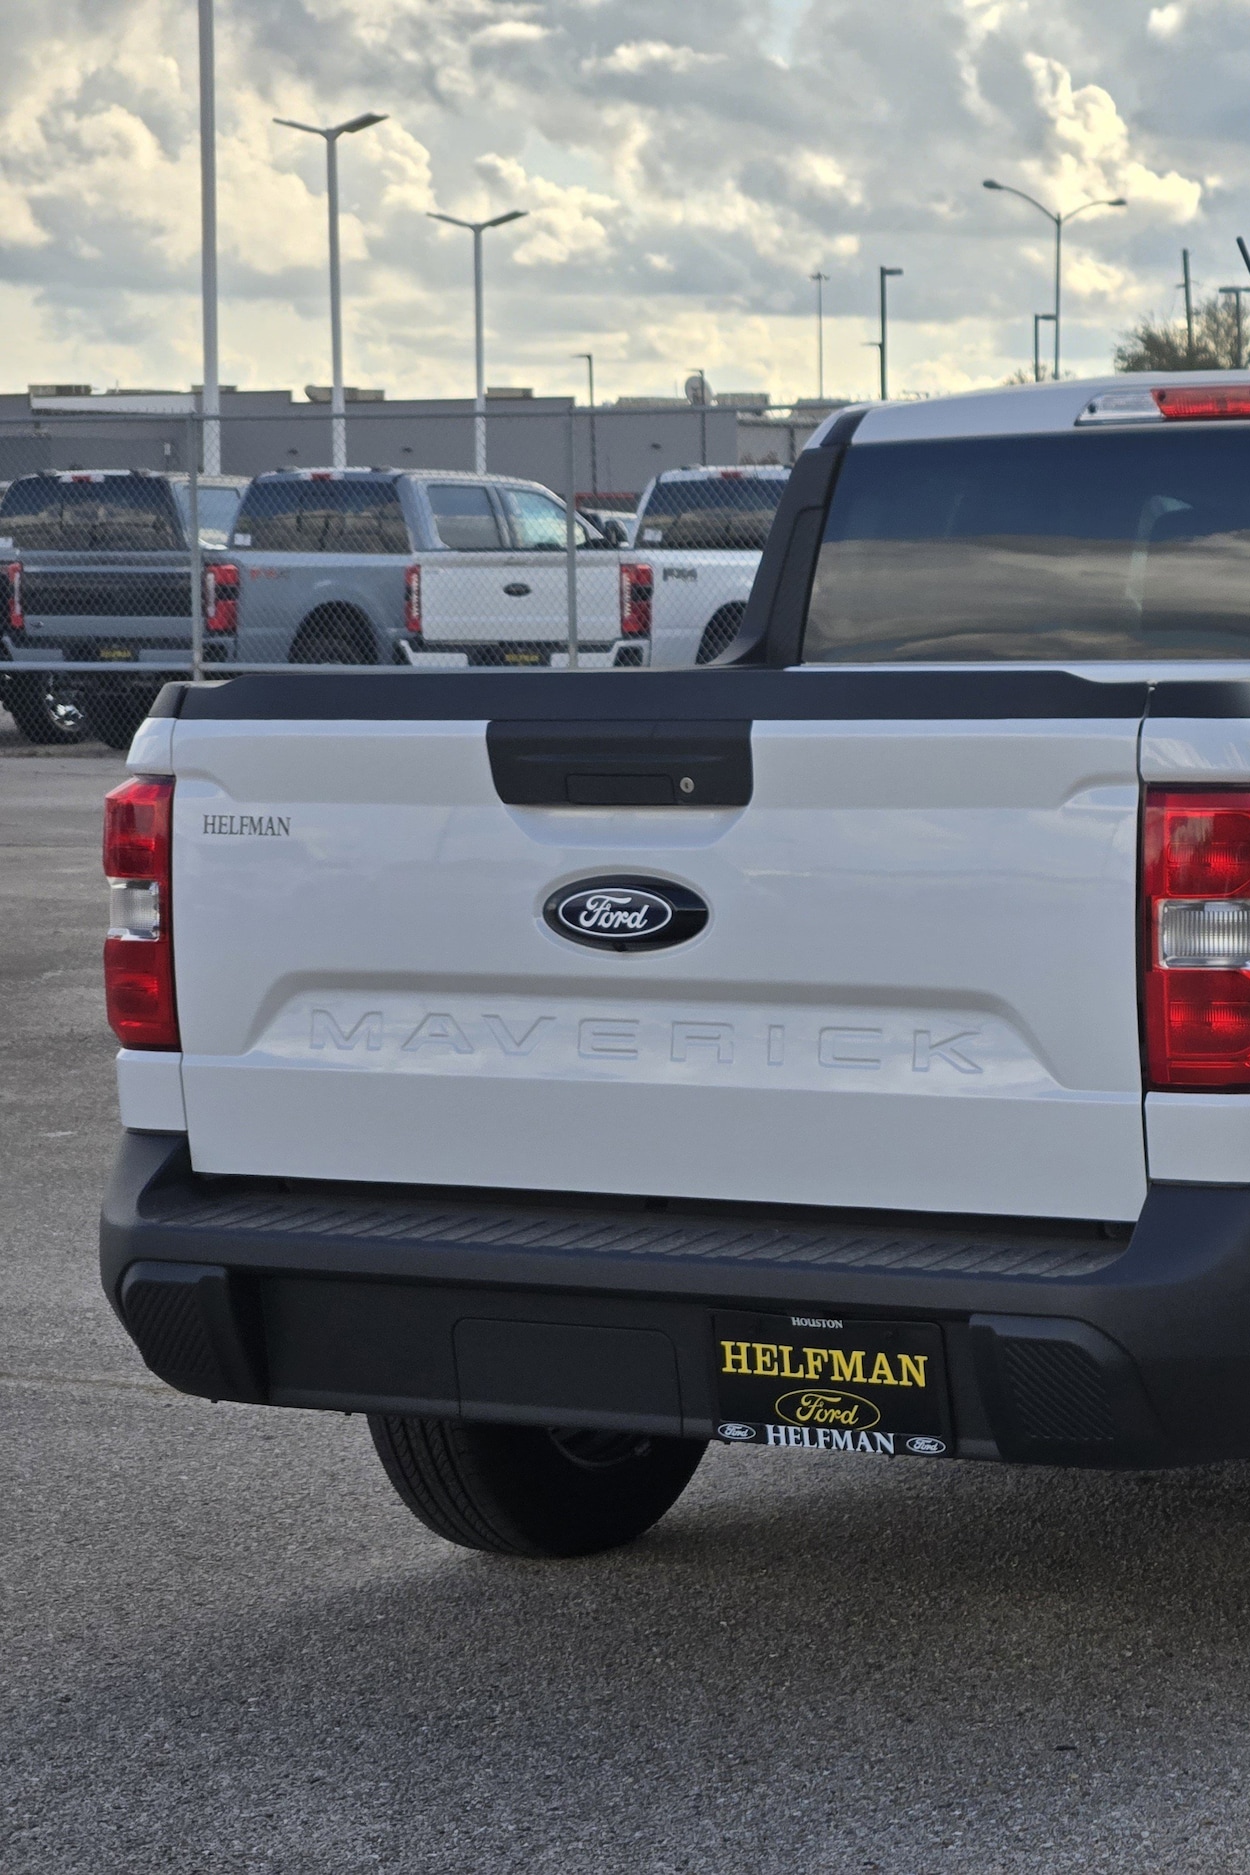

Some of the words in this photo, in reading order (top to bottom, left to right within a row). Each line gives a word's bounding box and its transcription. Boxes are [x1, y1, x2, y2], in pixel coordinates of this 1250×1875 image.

[202, 814, 291, 837] HELFMAN
[580, 895, 648, 930] Ford
[308, 1008, 984, 1074] MAVERICK
[791, 1316, 843, 1329] HOUSTON
[720, 1340, 928, 1388] HELFMAN
[795, 1392, 859, 1426] Ford
[724, 1424, 749, 1437] Ford
[765, 1423, 895, 1455] HELFMAN
[913, 1438, 939, 1451] Ford
